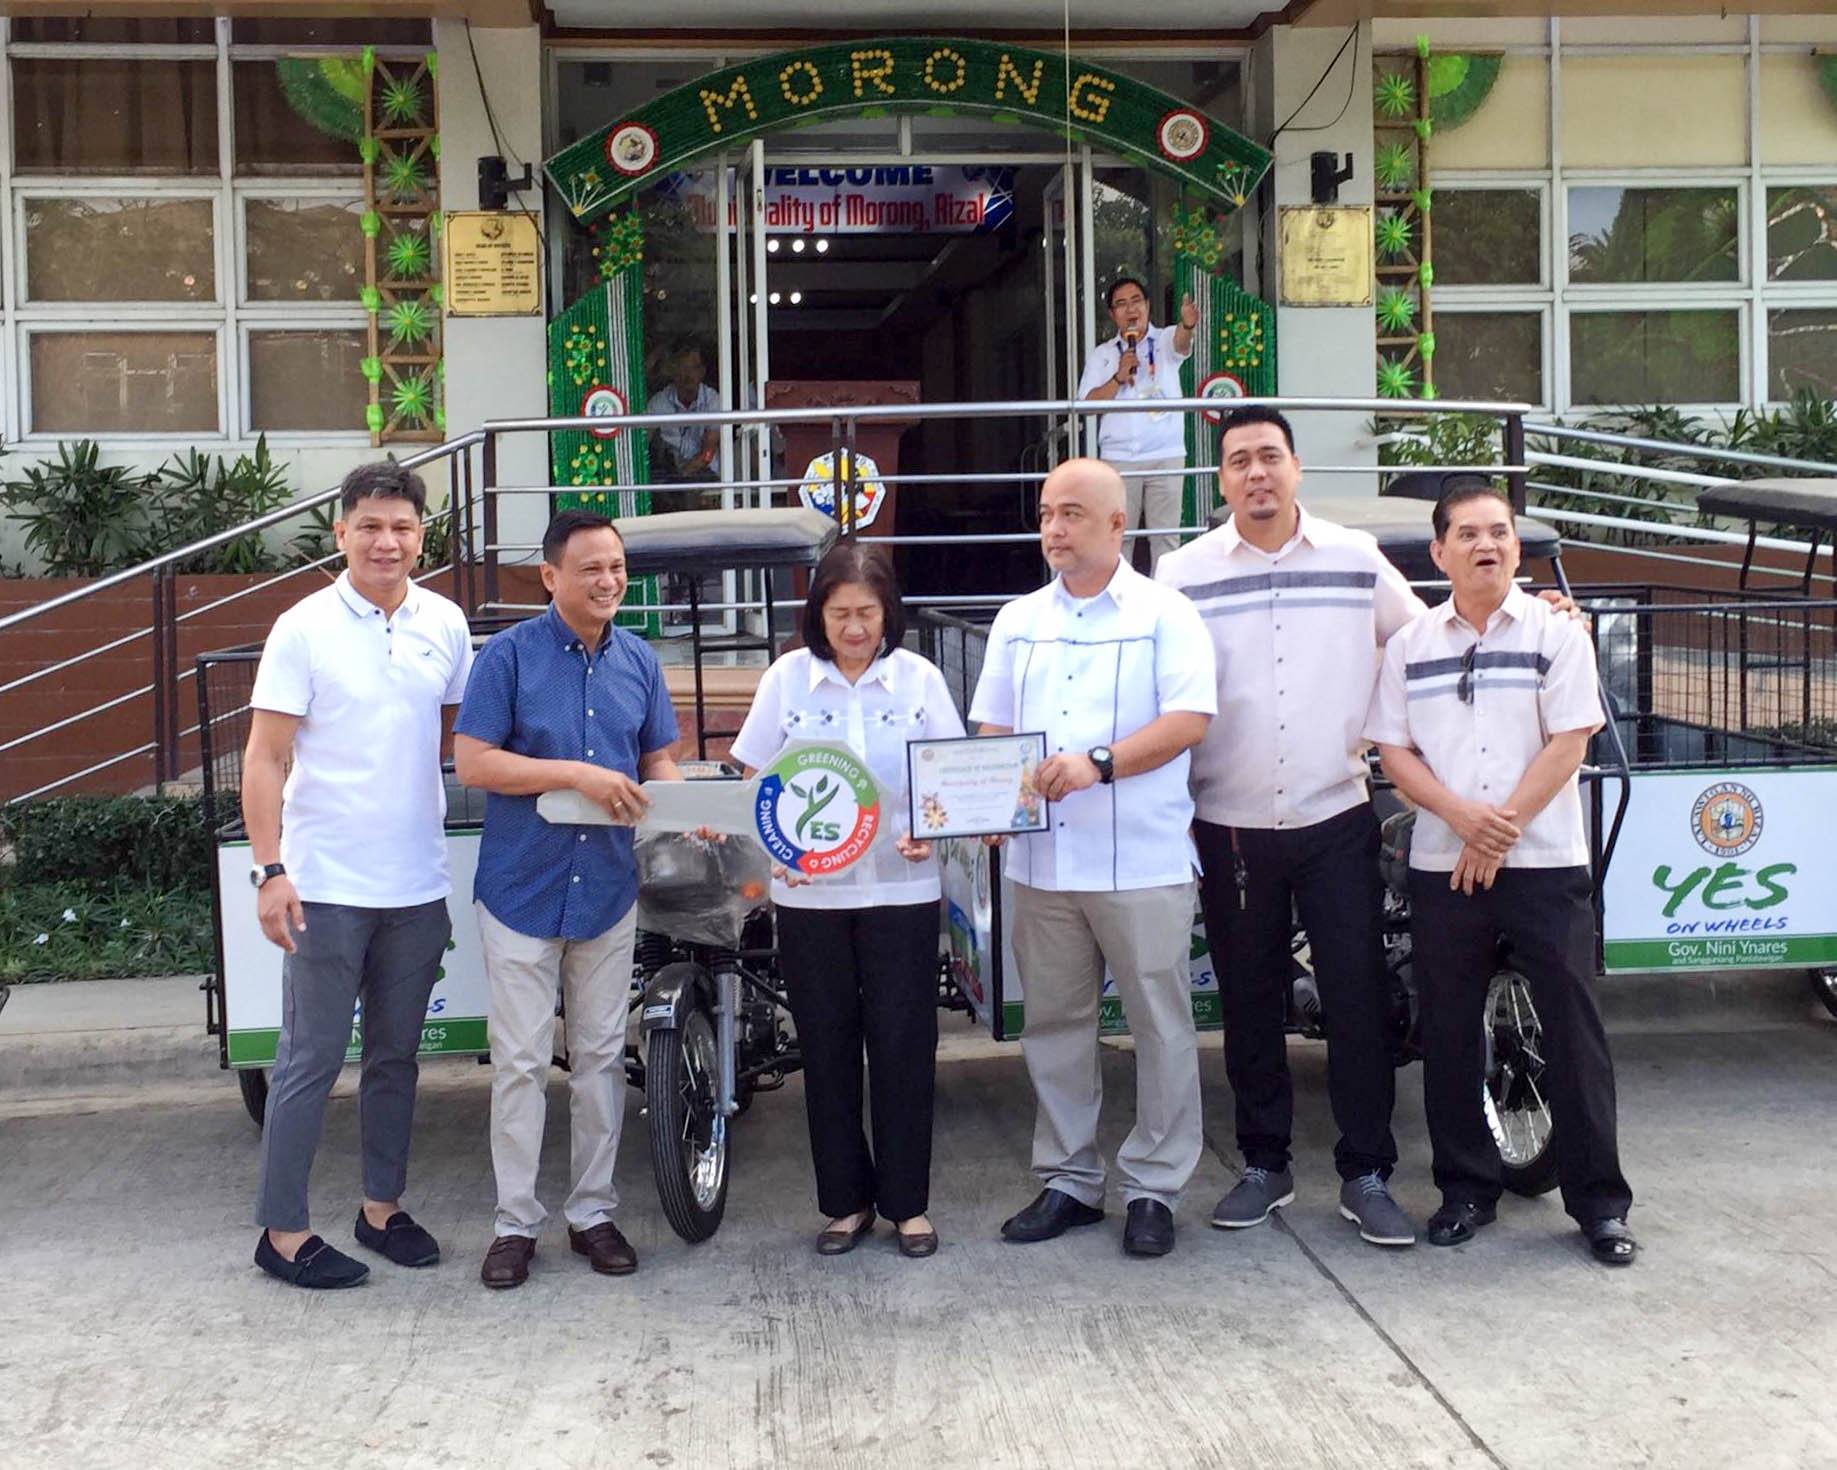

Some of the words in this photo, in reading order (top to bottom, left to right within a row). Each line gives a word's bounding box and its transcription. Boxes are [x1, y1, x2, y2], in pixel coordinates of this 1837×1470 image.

[699, 47, 1116, 133] MORONG
[764, 166, 934, 186] ELCOME
[819, 194, 842, 226] of
[846, 193, 930, 229] Morong,
[935, 192, 985, 225] Rizal
[797, 752, 860, 778] GREENING
[760, 799, 793, 861] CLEANING
[820, 814, 874, 869] RECYCLING
[1652, 862, 1798, 918] YES
[1666, 921, 1699, 934] ON
[1704, 916, 1789, 932] WHEELS
[1668, 942, 1702, 957] Gov.
[1705, 940, 1737, 955] Nini
[1739, 940, 1788, 954] Ynares
